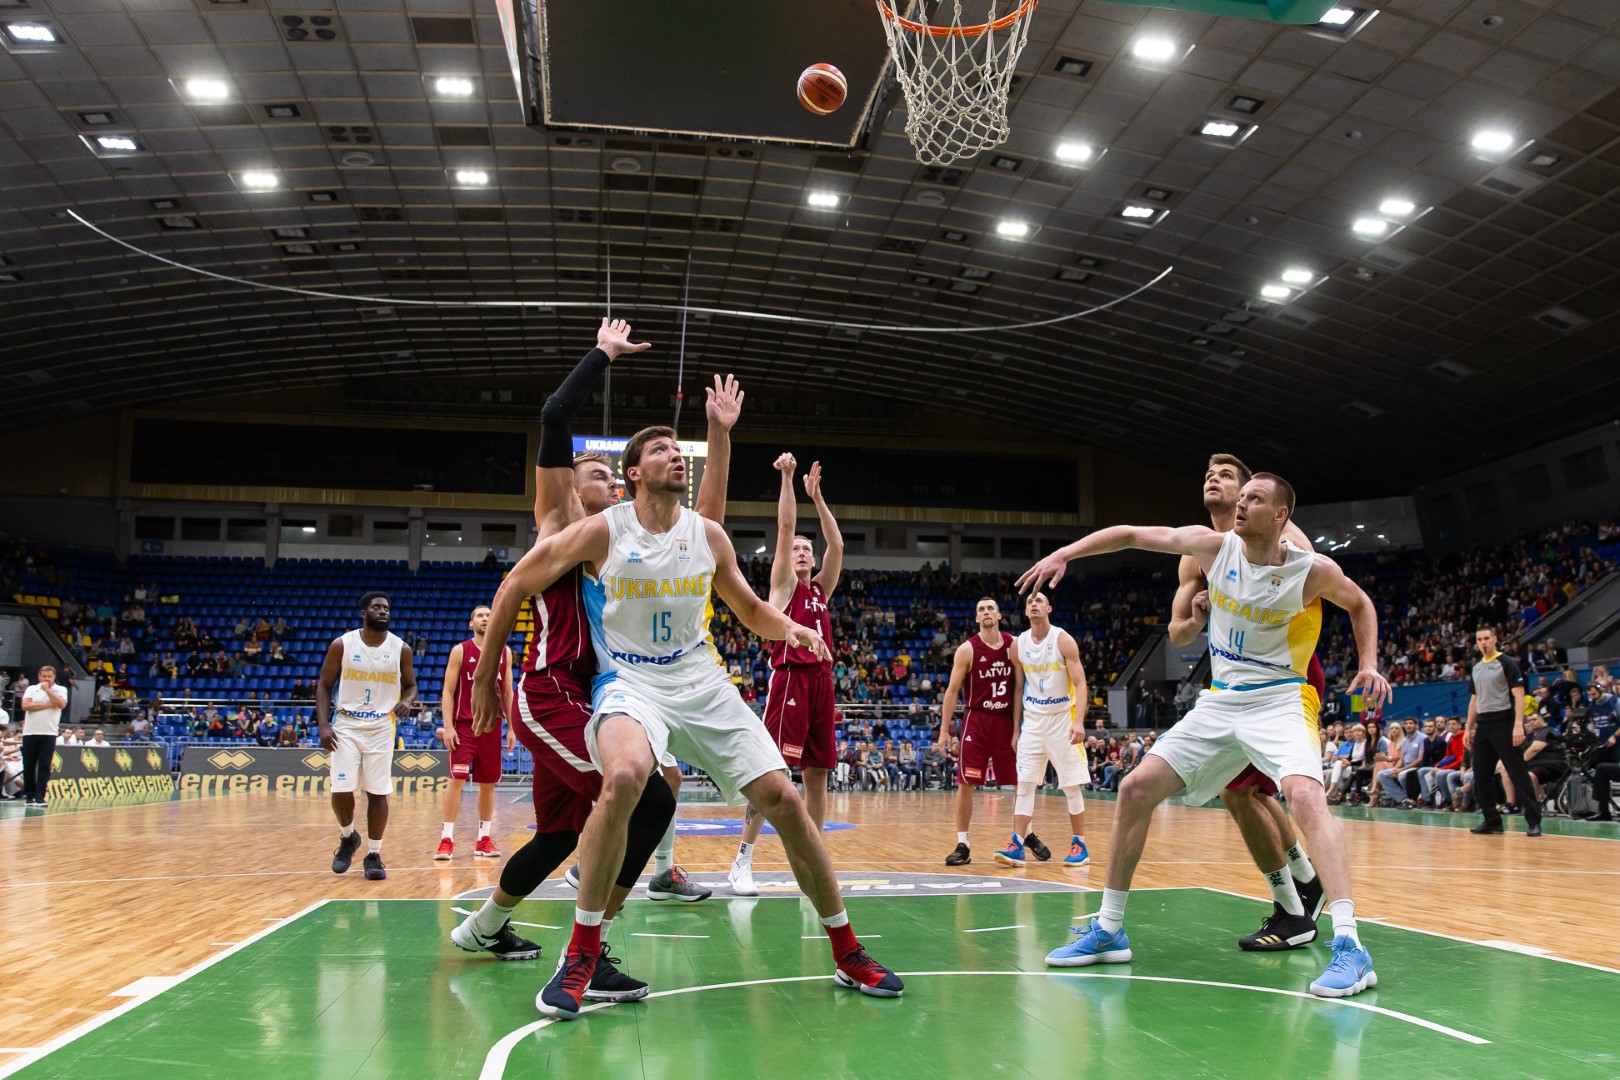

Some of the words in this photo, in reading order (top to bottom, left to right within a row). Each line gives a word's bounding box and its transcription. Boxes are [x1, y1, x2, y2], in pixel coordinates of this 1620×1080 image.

[610, 573, 707, 600] UKRAINE
[1210, 582, 1289, 625] UKRAINE
[652, 611, 672, 643] 15
[1229, 627, 1245, 655] 14
[342, 667, 398, 685] UKRAINE
[363, 688, 371, 706] 3
[991, 681, 1007, 698] 15
[275, 774, 332, 792] erre
[391, 775, 450, 793] rrea
